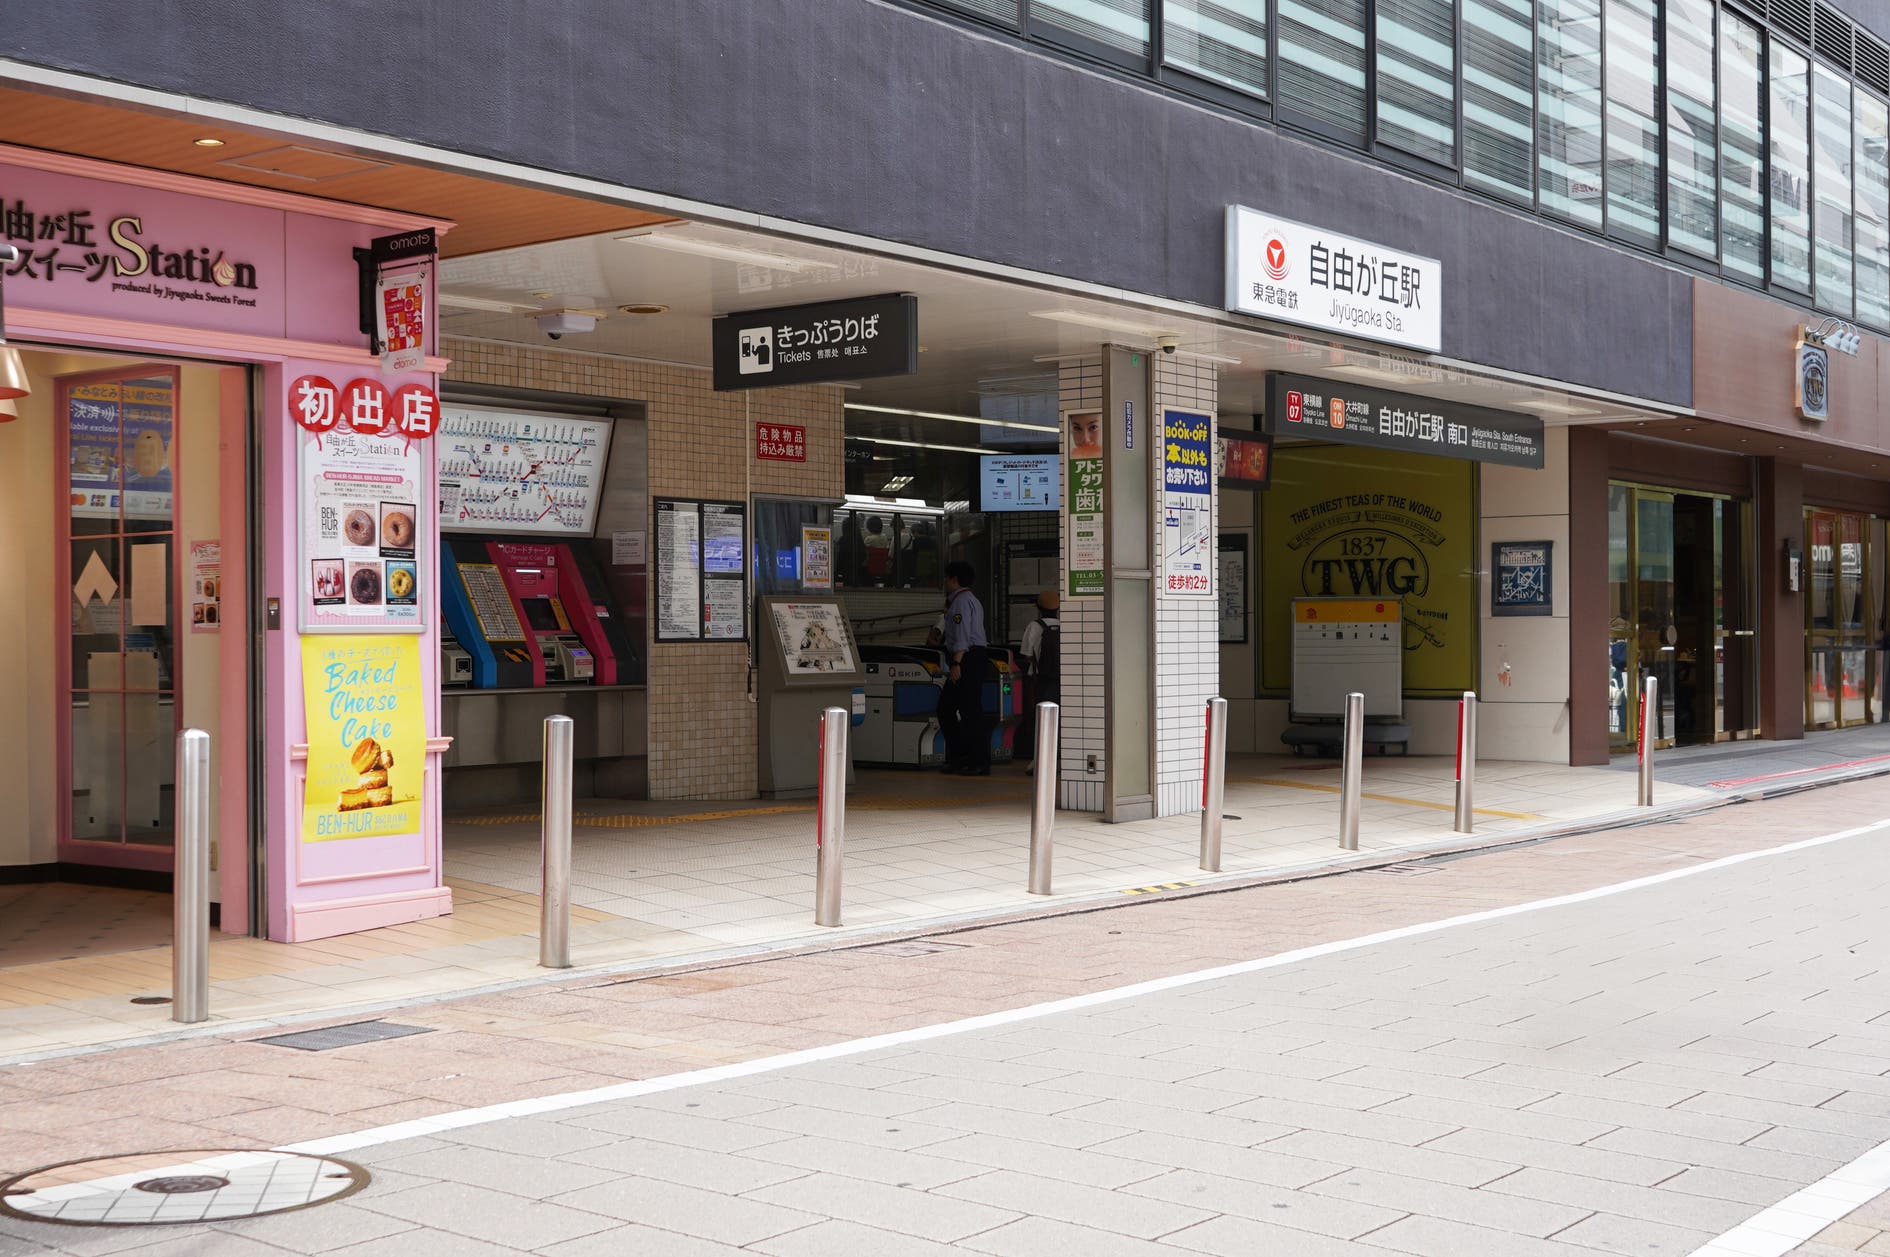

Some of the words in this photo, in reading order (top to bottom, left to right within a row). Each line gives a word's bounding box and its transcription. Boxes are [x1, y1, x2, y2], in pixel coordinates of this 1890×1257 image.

[0, 199, 97, 248] 由が丘
[6, 248, 111, 282] スイーツ
[1310, 241, 1421, 310] 自由が丘駅
[112, 281, 152, 294] produced
[153, 283, 164, 298] by
[164, 287, 204, 302] Jiyugaoka
[205, 292, 231, 305] Sweets
[232, 296, 257, 308] Forest
[1252, 282, 1299, 310] 東急電鉄
[1329, 298, 1383, 327] Jiyūgaoka
[1385, 310, 1405, 333] Sta.
[777, 313, 880, 348] きっぷうりば
[778, 350, 811, 364] Tickets
[817, 348, 839, 360] 售票处
[298, 380, 433, 433] 初出店
[1291, 395, 1299, 404] TY
[1345, 400, 1370, 416] 大井町線
[1289, 405, 1299, 419] 07
[1333, 412, 1343, 425] 10
[760, 427, 803, 443] 危険物品
[1379, 405, 1444, 444] 自由が丘駅
[1447, 422, 1468, 446] 南口
[326, 433, 356, 447] 自由が丘
[760, 441, 803, 457] 持込み厳禁
[1501, 431, 1514, 442] South
[1514, 433, 1532, 445] Entrance
[332, 447, 360, 457] スイーツ
[1166, 443, 1208, 467] 本以外も
[1166, 467, 1208, 486] お売り下さい
[321, 507, 338, 519] BEN-
[1290, 511, 1311, 524] THE
[1311, 497, 1343, 517] FINEST
[1345, 494, 1370, 507] TEAS
[1372, 494, 1385, 505] OF
[1387, 495, 1407, 509] THE
[1409, 499, 1442, 522] WORLD
[321, 519, 338, 531] HUR
[1340, 536, 1387, 557] 1837
[1168, 574, 1208, 590] 徒歩約2分
[1311, 557, 1419, 596] TWG
[324, 661, 398, 693] Baked
[330, 690, 398, 720] Cheese
[341, 718, 393, 748] Cake
[317, 812, 374, 835] BEN-HUR
